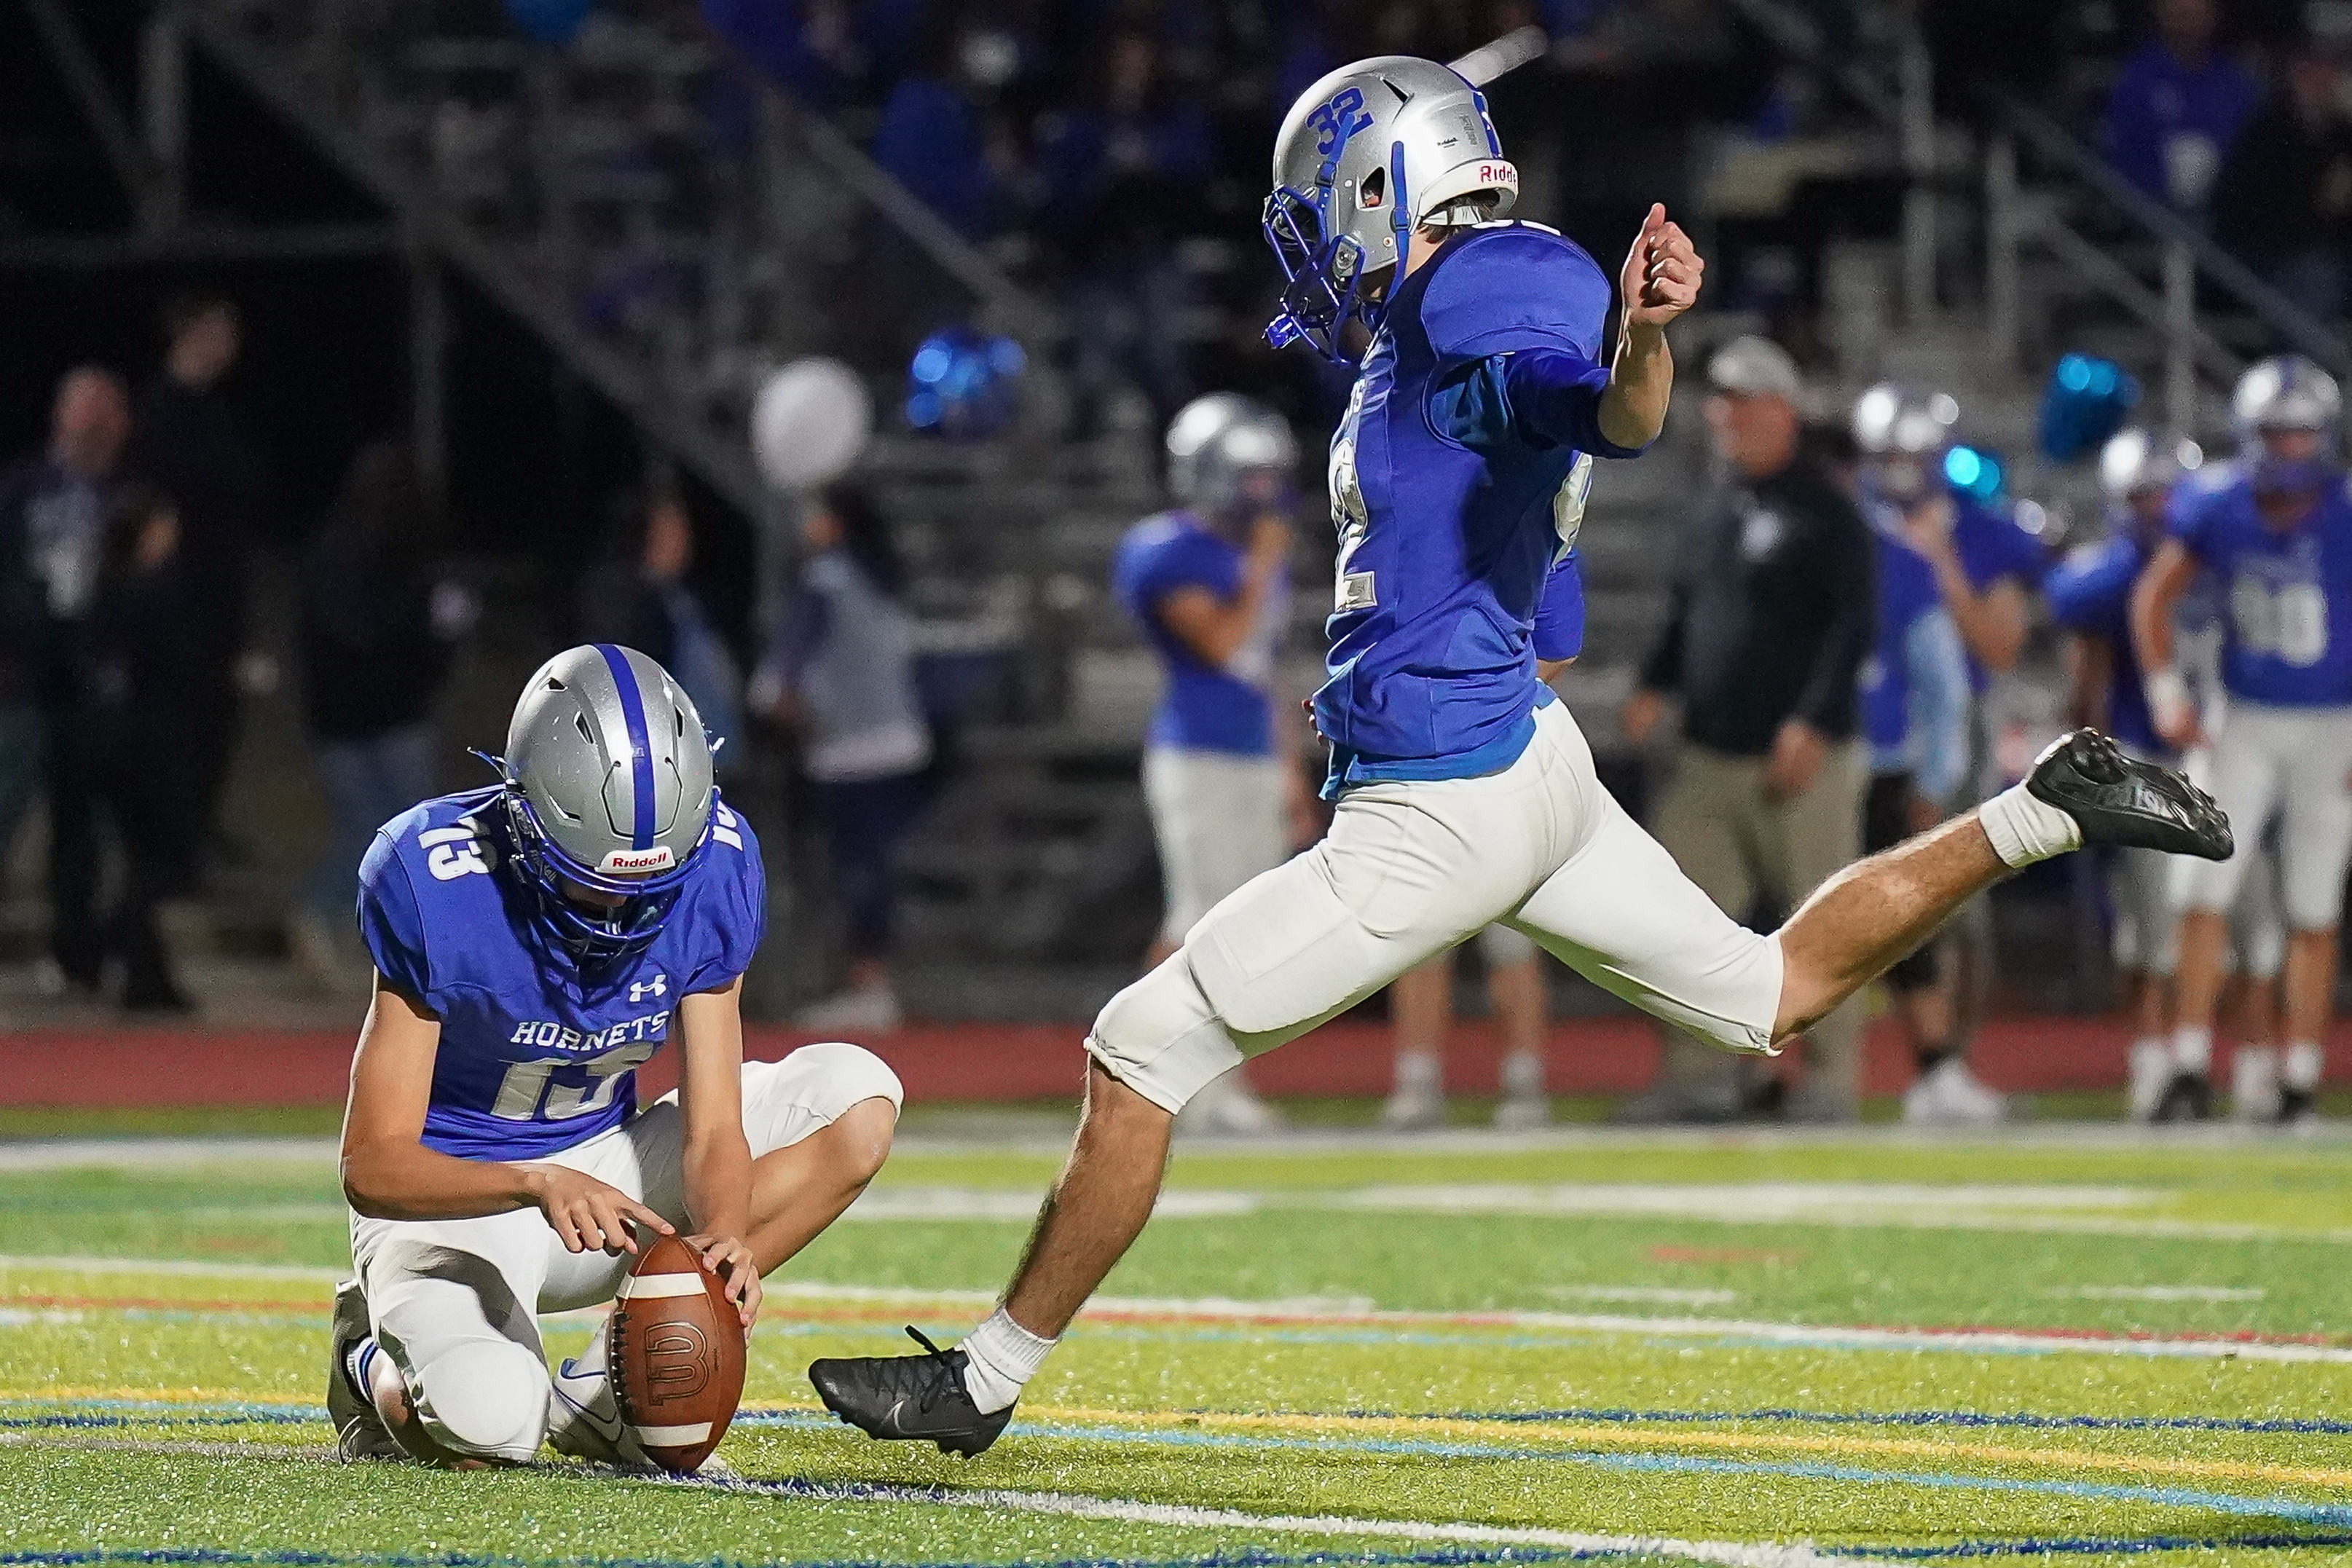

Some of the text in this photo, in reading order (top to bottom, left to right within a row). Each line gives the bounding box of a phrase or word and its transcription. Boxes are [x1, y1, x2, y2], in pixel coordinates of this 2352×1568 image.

[1305, 86, 1374, 156] 32
[1480, 165, 1517, 182] Ridd
[418, 816, 497, 880] 13
[613, 852, 666, 867] Riddell
[511, 1011, 669, 1051] HORNETS
